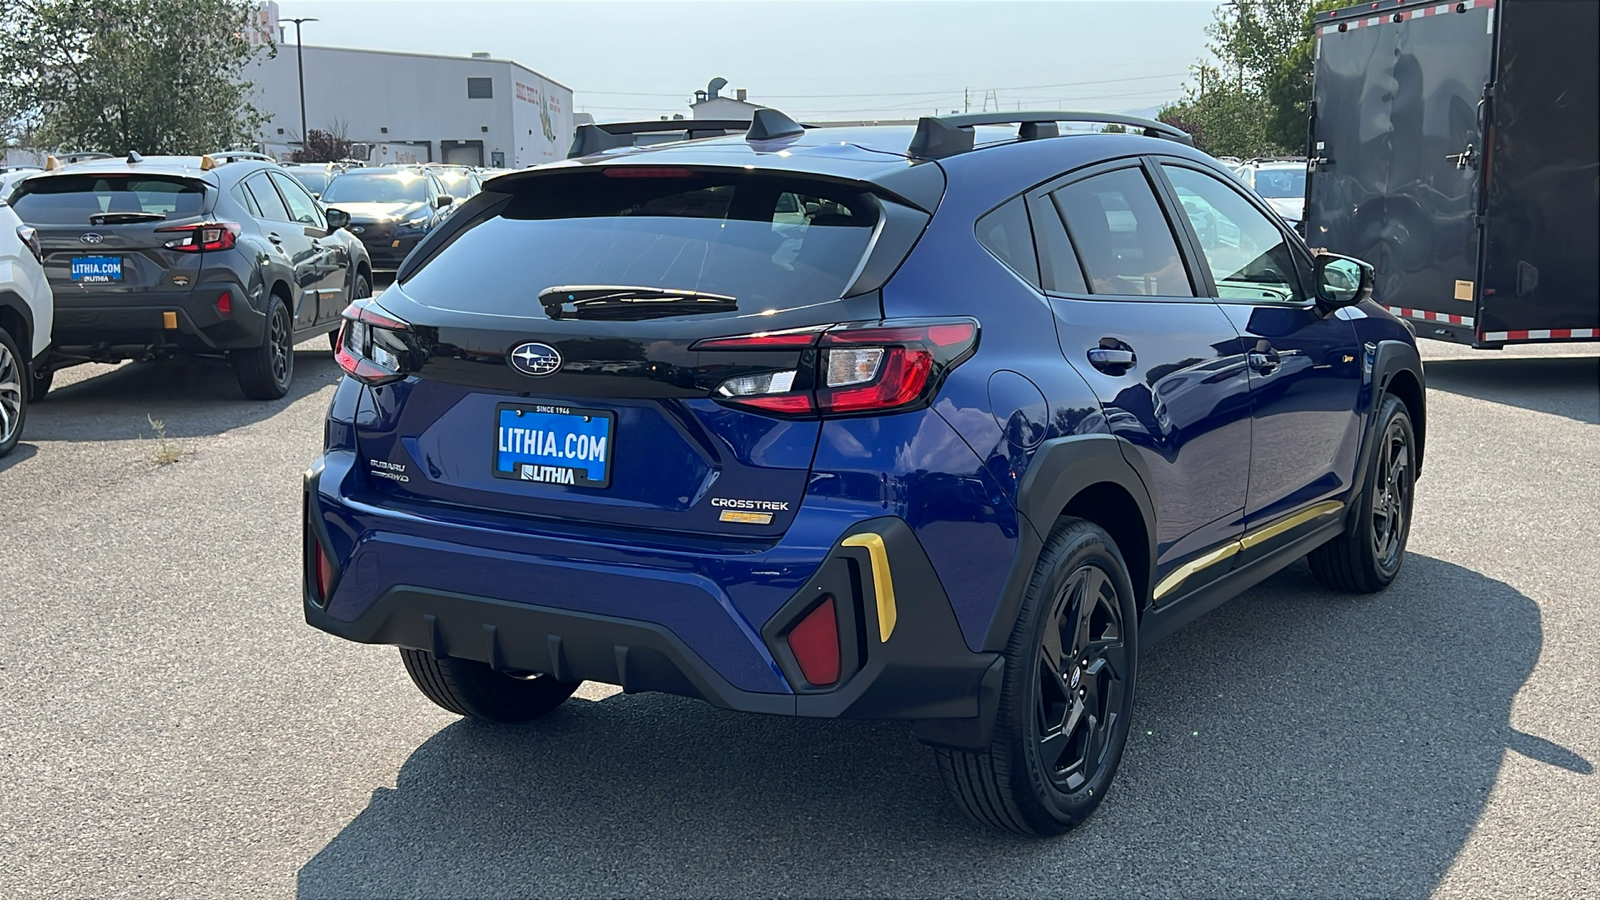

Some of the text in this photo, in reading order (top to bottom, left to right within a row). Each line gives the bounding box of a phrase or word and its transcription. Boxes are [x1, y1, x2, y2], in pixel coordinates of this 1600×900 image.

[72, 263, 121, 274] LITHIA.COM
[536, 405, 570, 415] SINCE 1946
[499, 426, 607, 463] LITHIA.COM
[370, 459, 406, 472] SUBARU
[532, 465, 575, 485] LITHIA
[711, 498, 789, 511] CROSSTREK
